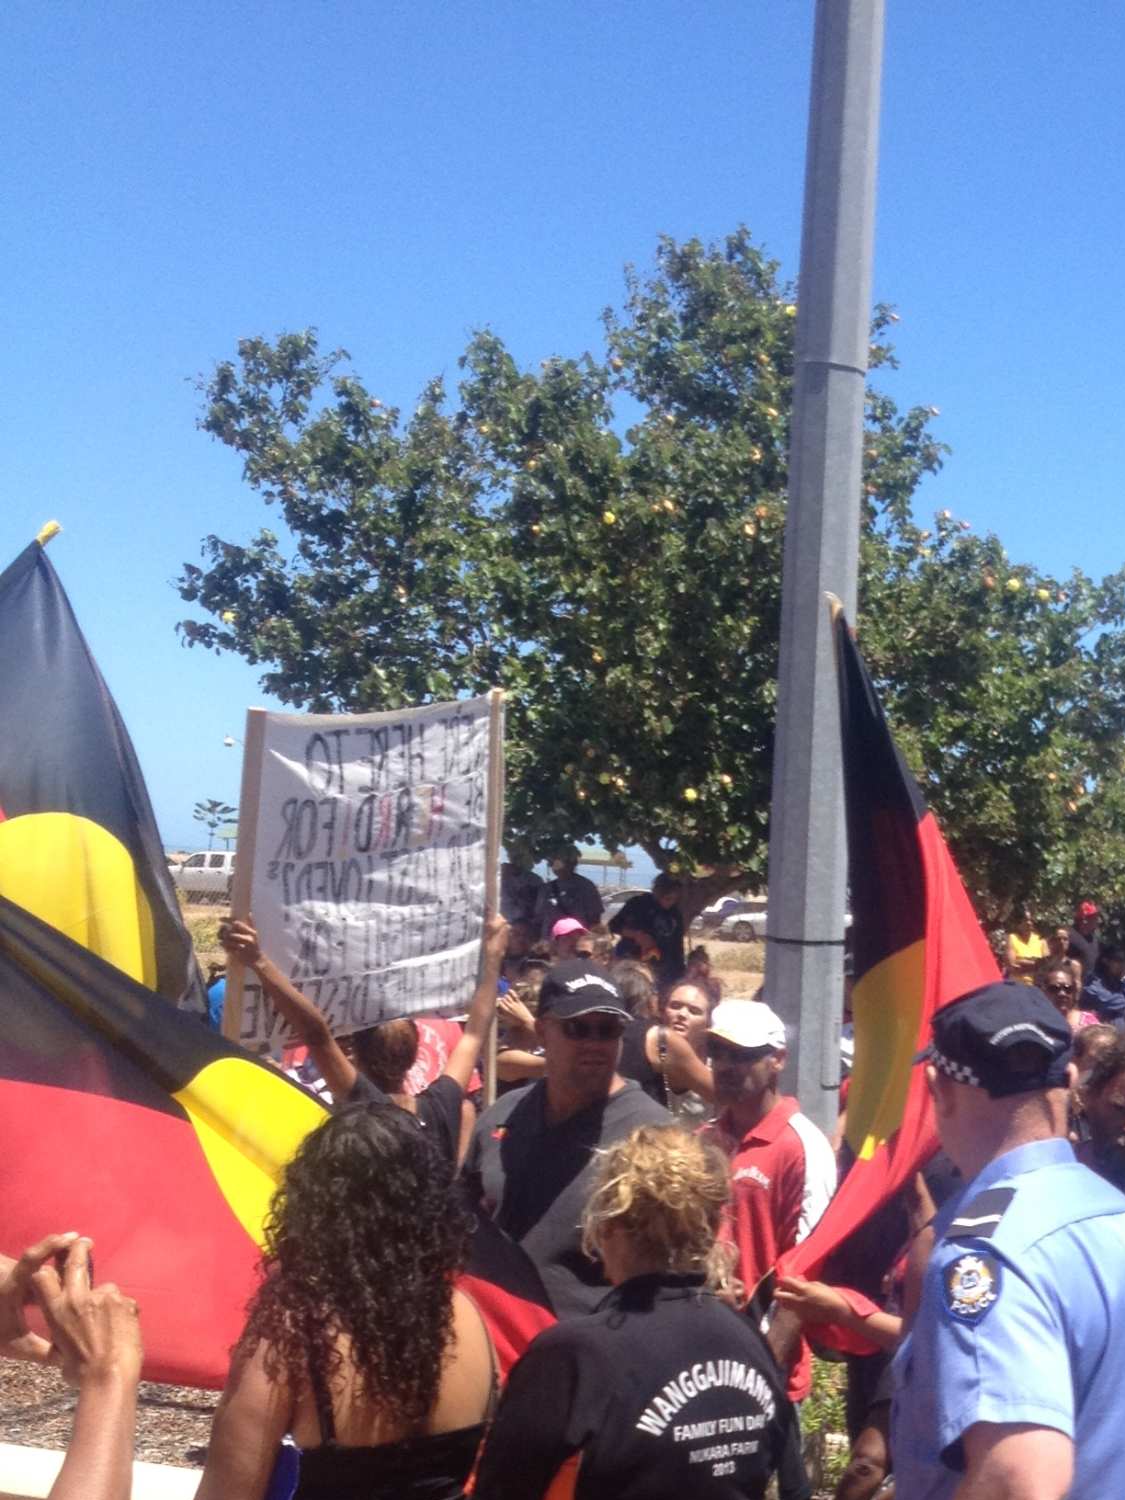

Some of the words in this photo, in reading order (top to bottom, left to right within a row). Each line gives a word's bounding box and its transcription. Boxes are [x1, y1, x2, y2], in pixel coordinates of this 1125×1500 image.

[949, 1293, 998, 1316] POLICE
[673, 1420, 719, 1442] FAMILY
[719, 1416, 745, 1434] FUN
[746, 1414, 767, 1430] DAY
